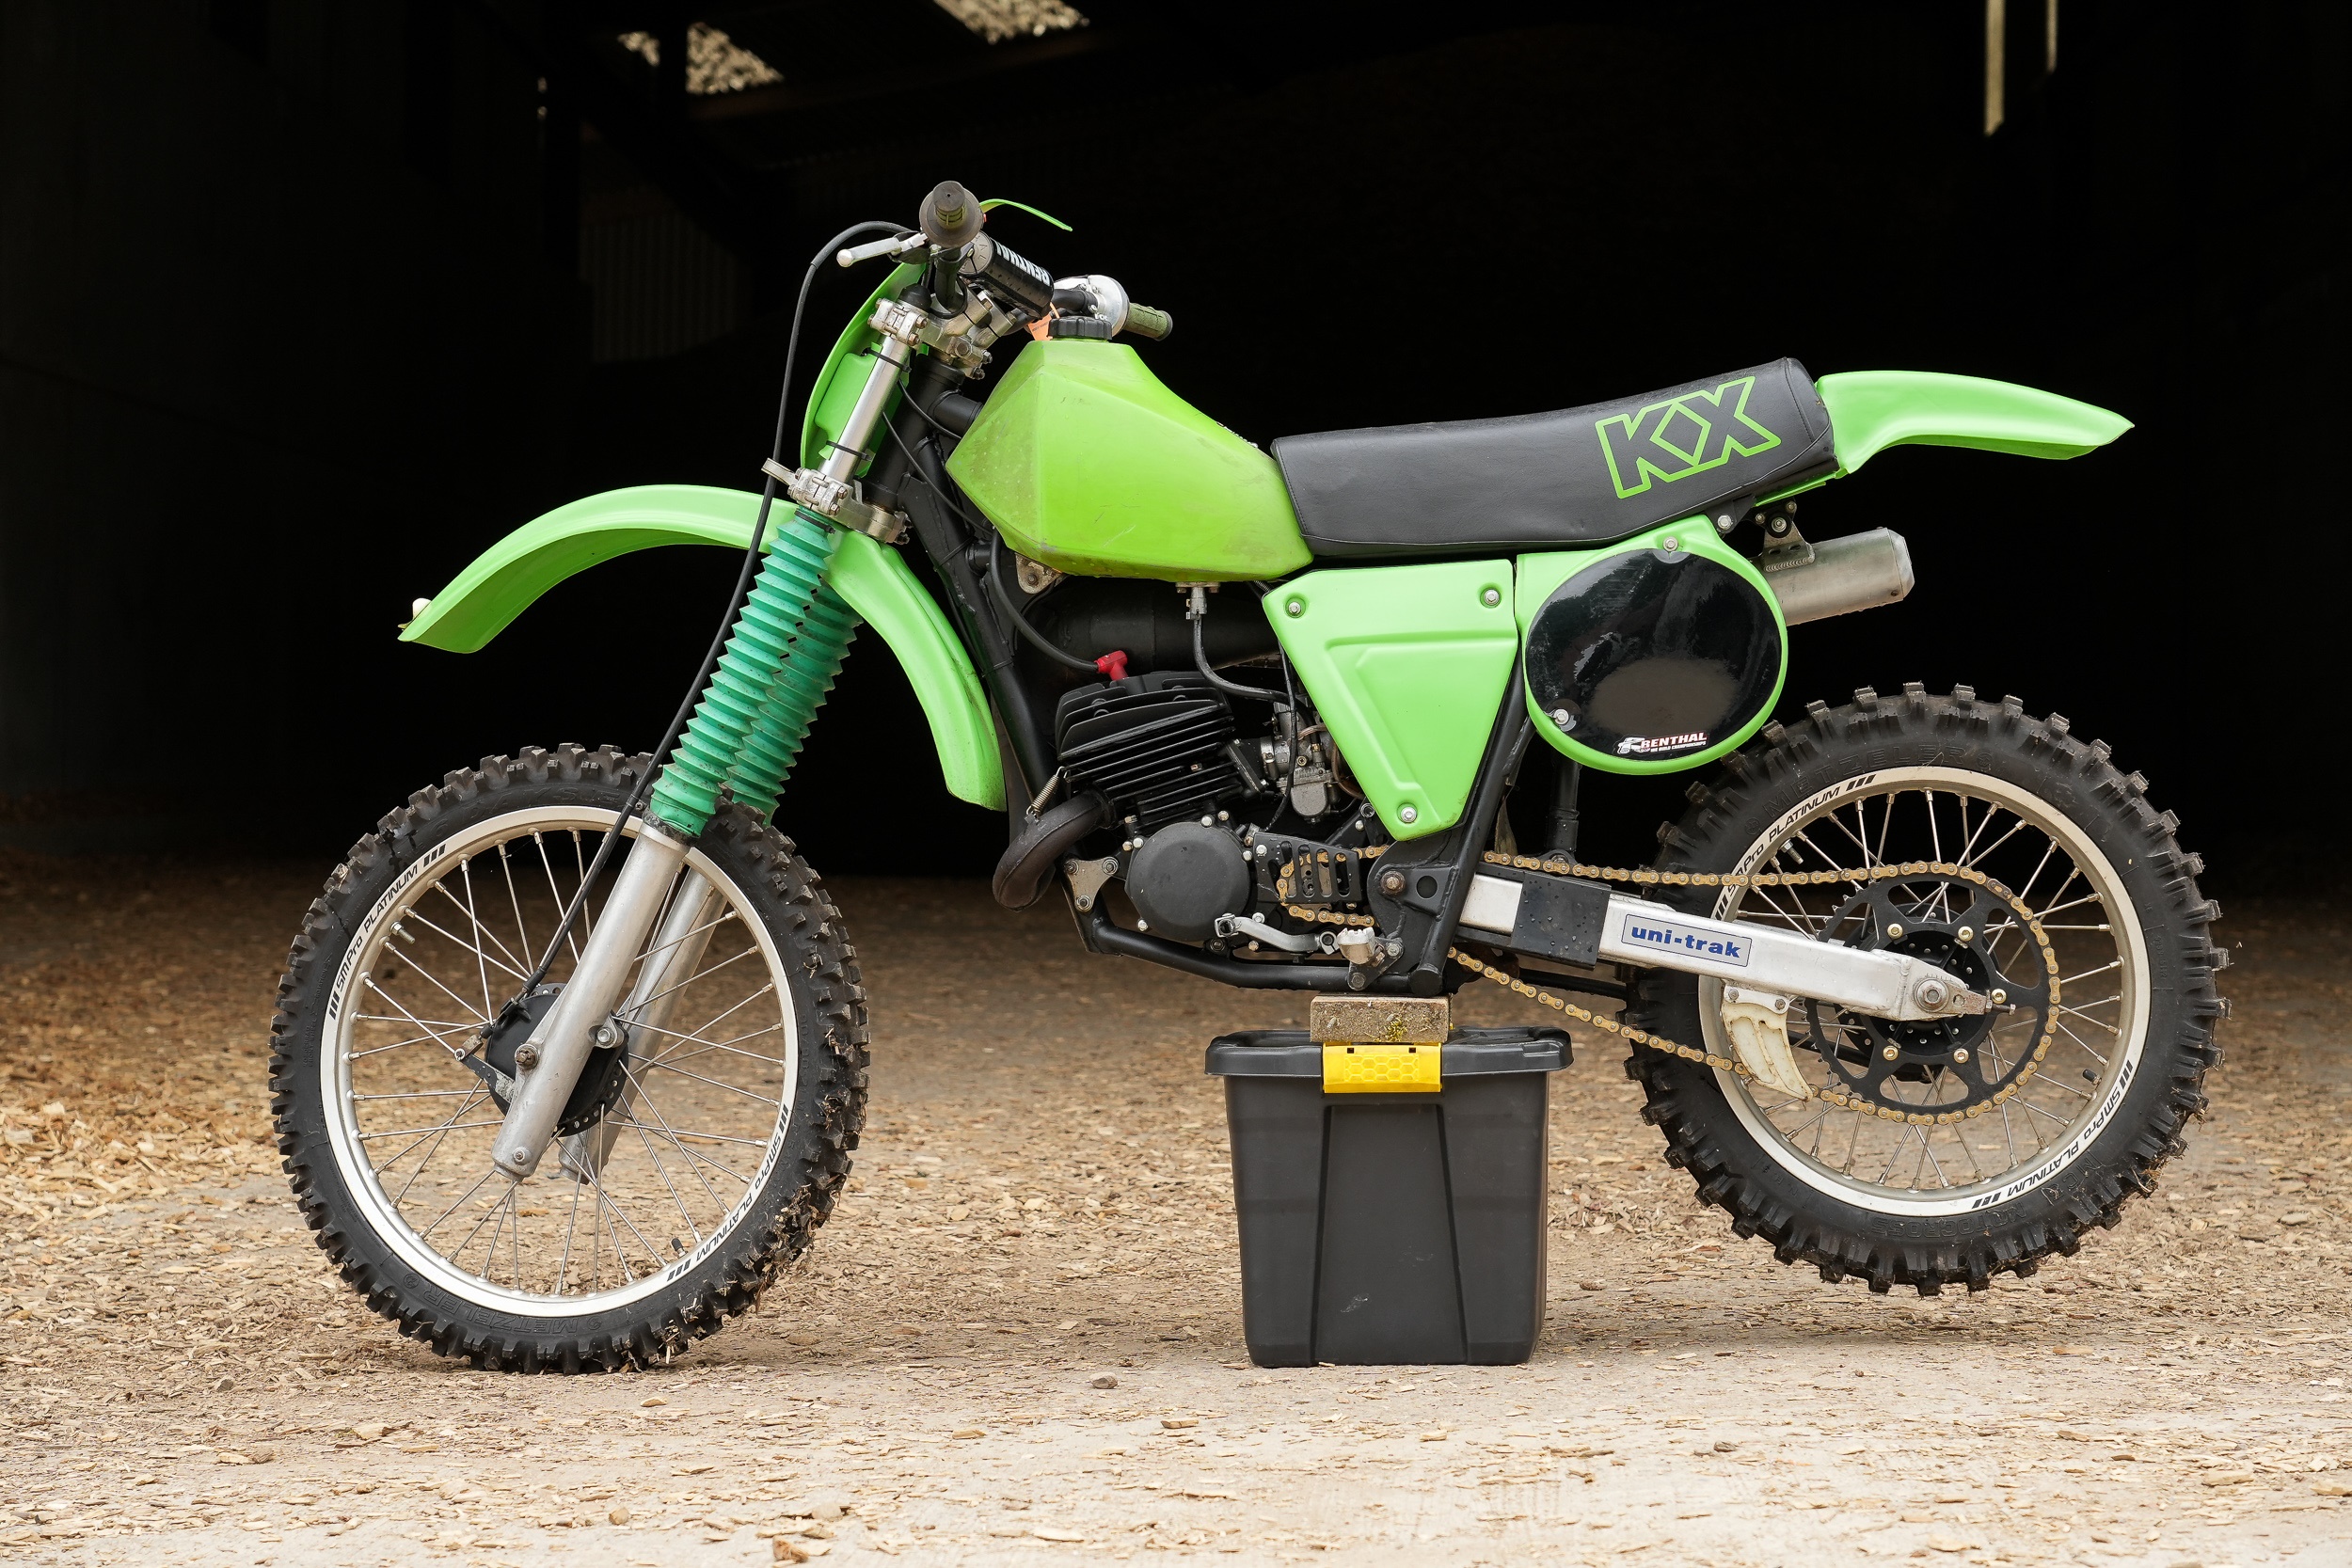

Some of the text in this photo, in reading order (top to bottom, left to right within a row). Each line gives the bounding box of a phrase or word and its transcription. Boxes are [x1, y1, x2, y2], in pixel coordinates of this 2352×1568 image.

[1595, 375, 1782, 499] KX
[1641, 732, 1708, 749] RENTHAL
[1762, 744, 1965, 817] METZELER
[1769, 786, 1840, 842] PLATINUM
[363, 863, 419, 933] PLATINUM
[1631, 926, 1740, 958] uni-trak
[2007, 1141, 2079, 1197] PLATINUM
[696, 1192, 753, 1262] PLATINUM
[1870, 1202, 2028, 1239] MOTOCROSS
[423, 1282, 579, 1334] METZELER
